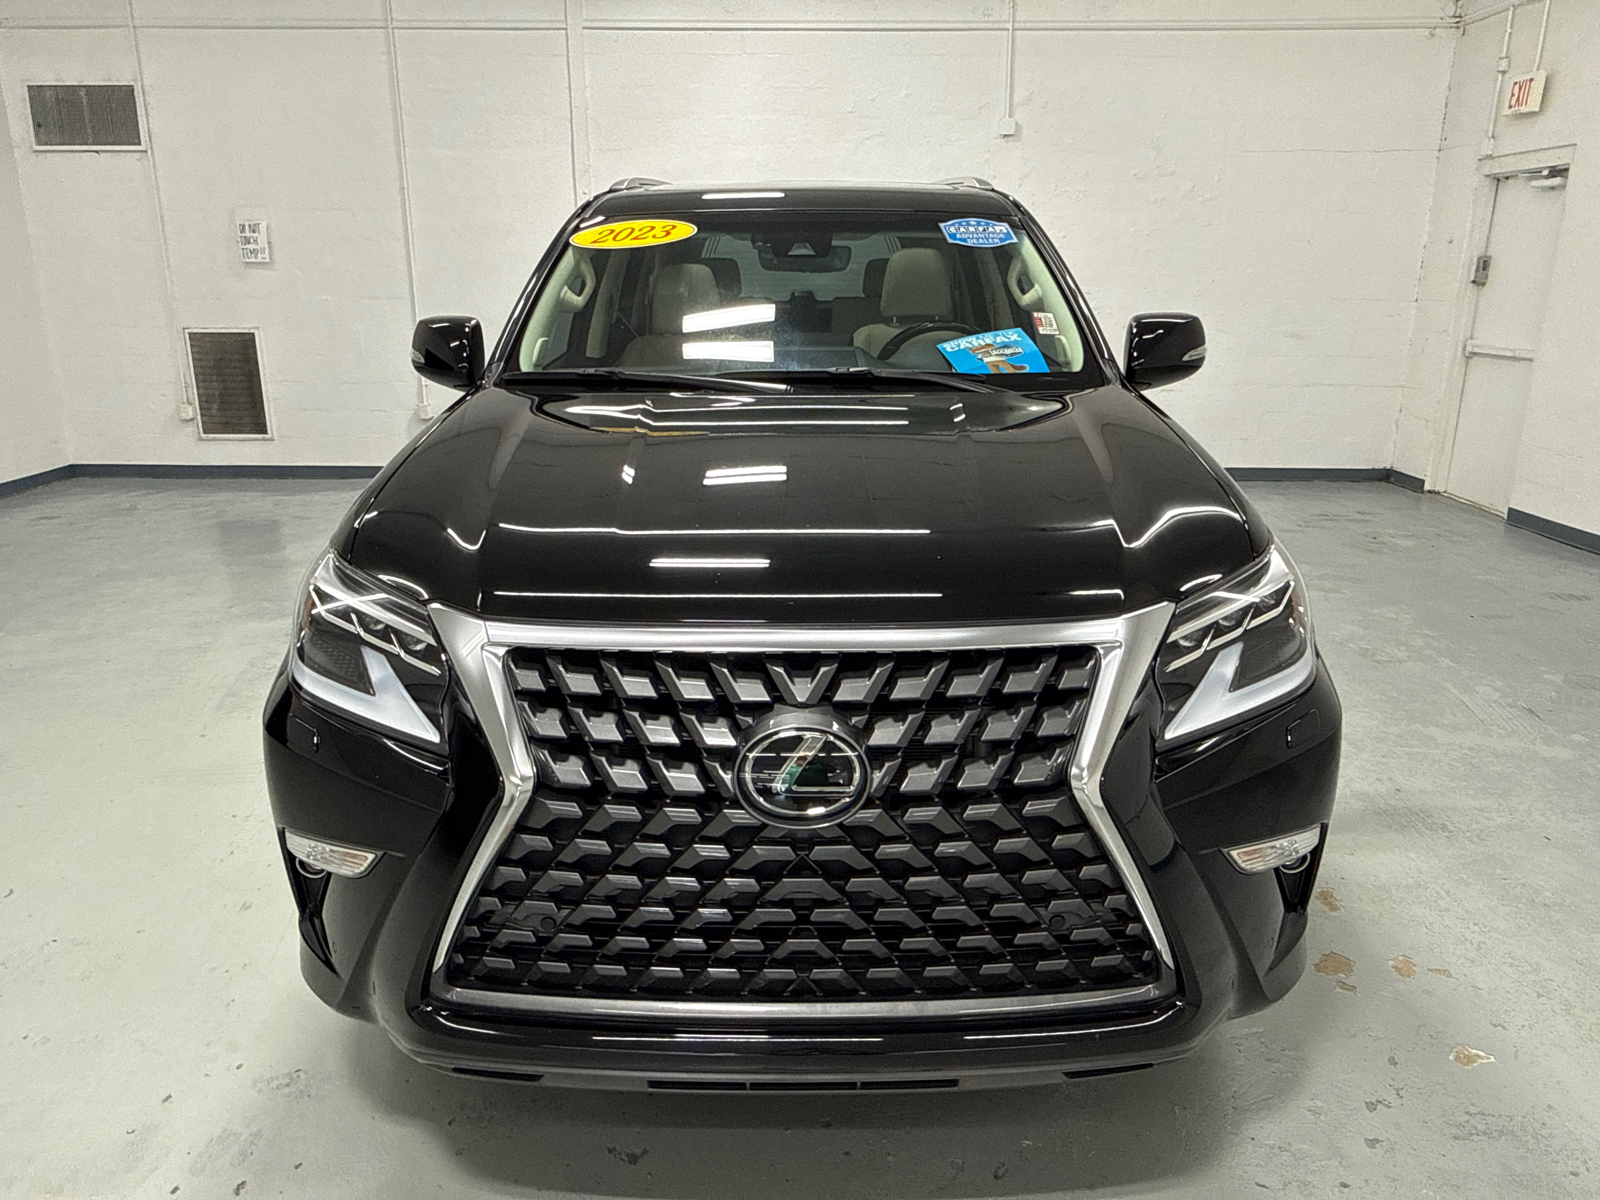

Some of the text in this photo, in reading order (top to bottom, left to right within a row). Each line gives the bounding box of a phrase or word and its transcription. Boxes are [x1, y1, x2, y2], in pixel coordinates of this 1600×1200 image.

[1508, 77, 1534, 110] EXIT
[239, 223, 261, 234] DO NOT
[589, 224, 678, 244] 2023
[239, 236, 258, 246] TOUCH
[942, 336, 977, 349] SHOW
[944, 333, 1023, 353] CARFAX
